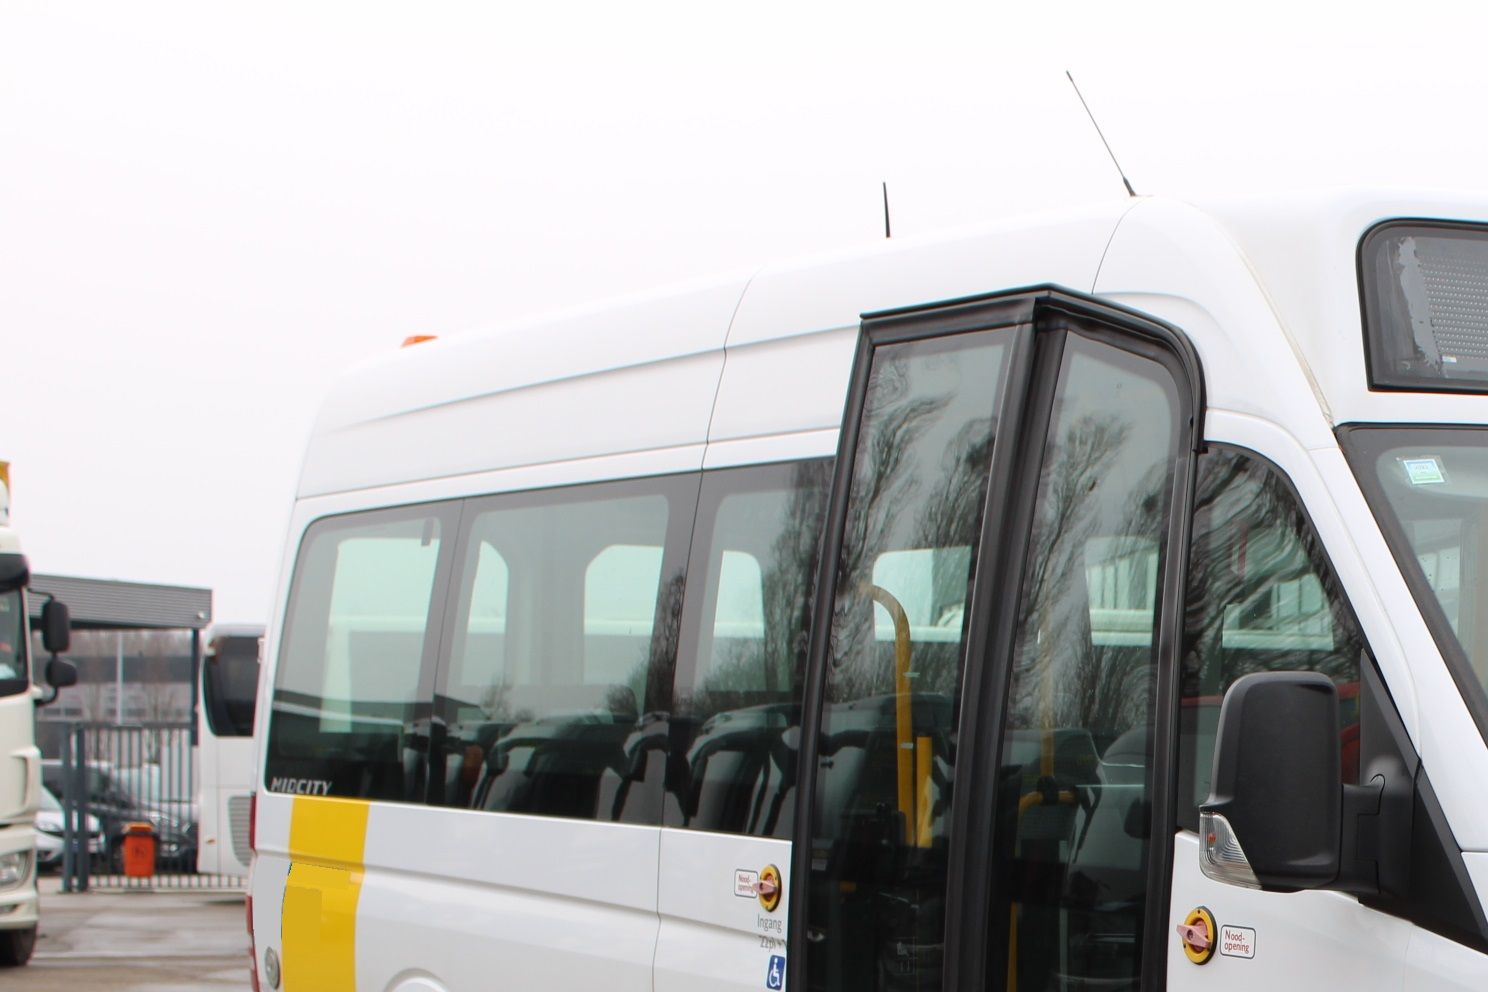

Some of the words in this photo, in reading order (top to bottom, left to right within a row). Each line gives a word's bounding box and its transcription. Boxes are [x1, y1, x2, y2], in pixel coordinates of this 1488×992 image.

[270, 777, 332, 796] MIDCITY
[757, 912, 782, 934] Ingang
[1225, 929, 1246, 942] Nood-
[1224, 941, 1250, 954] opening
